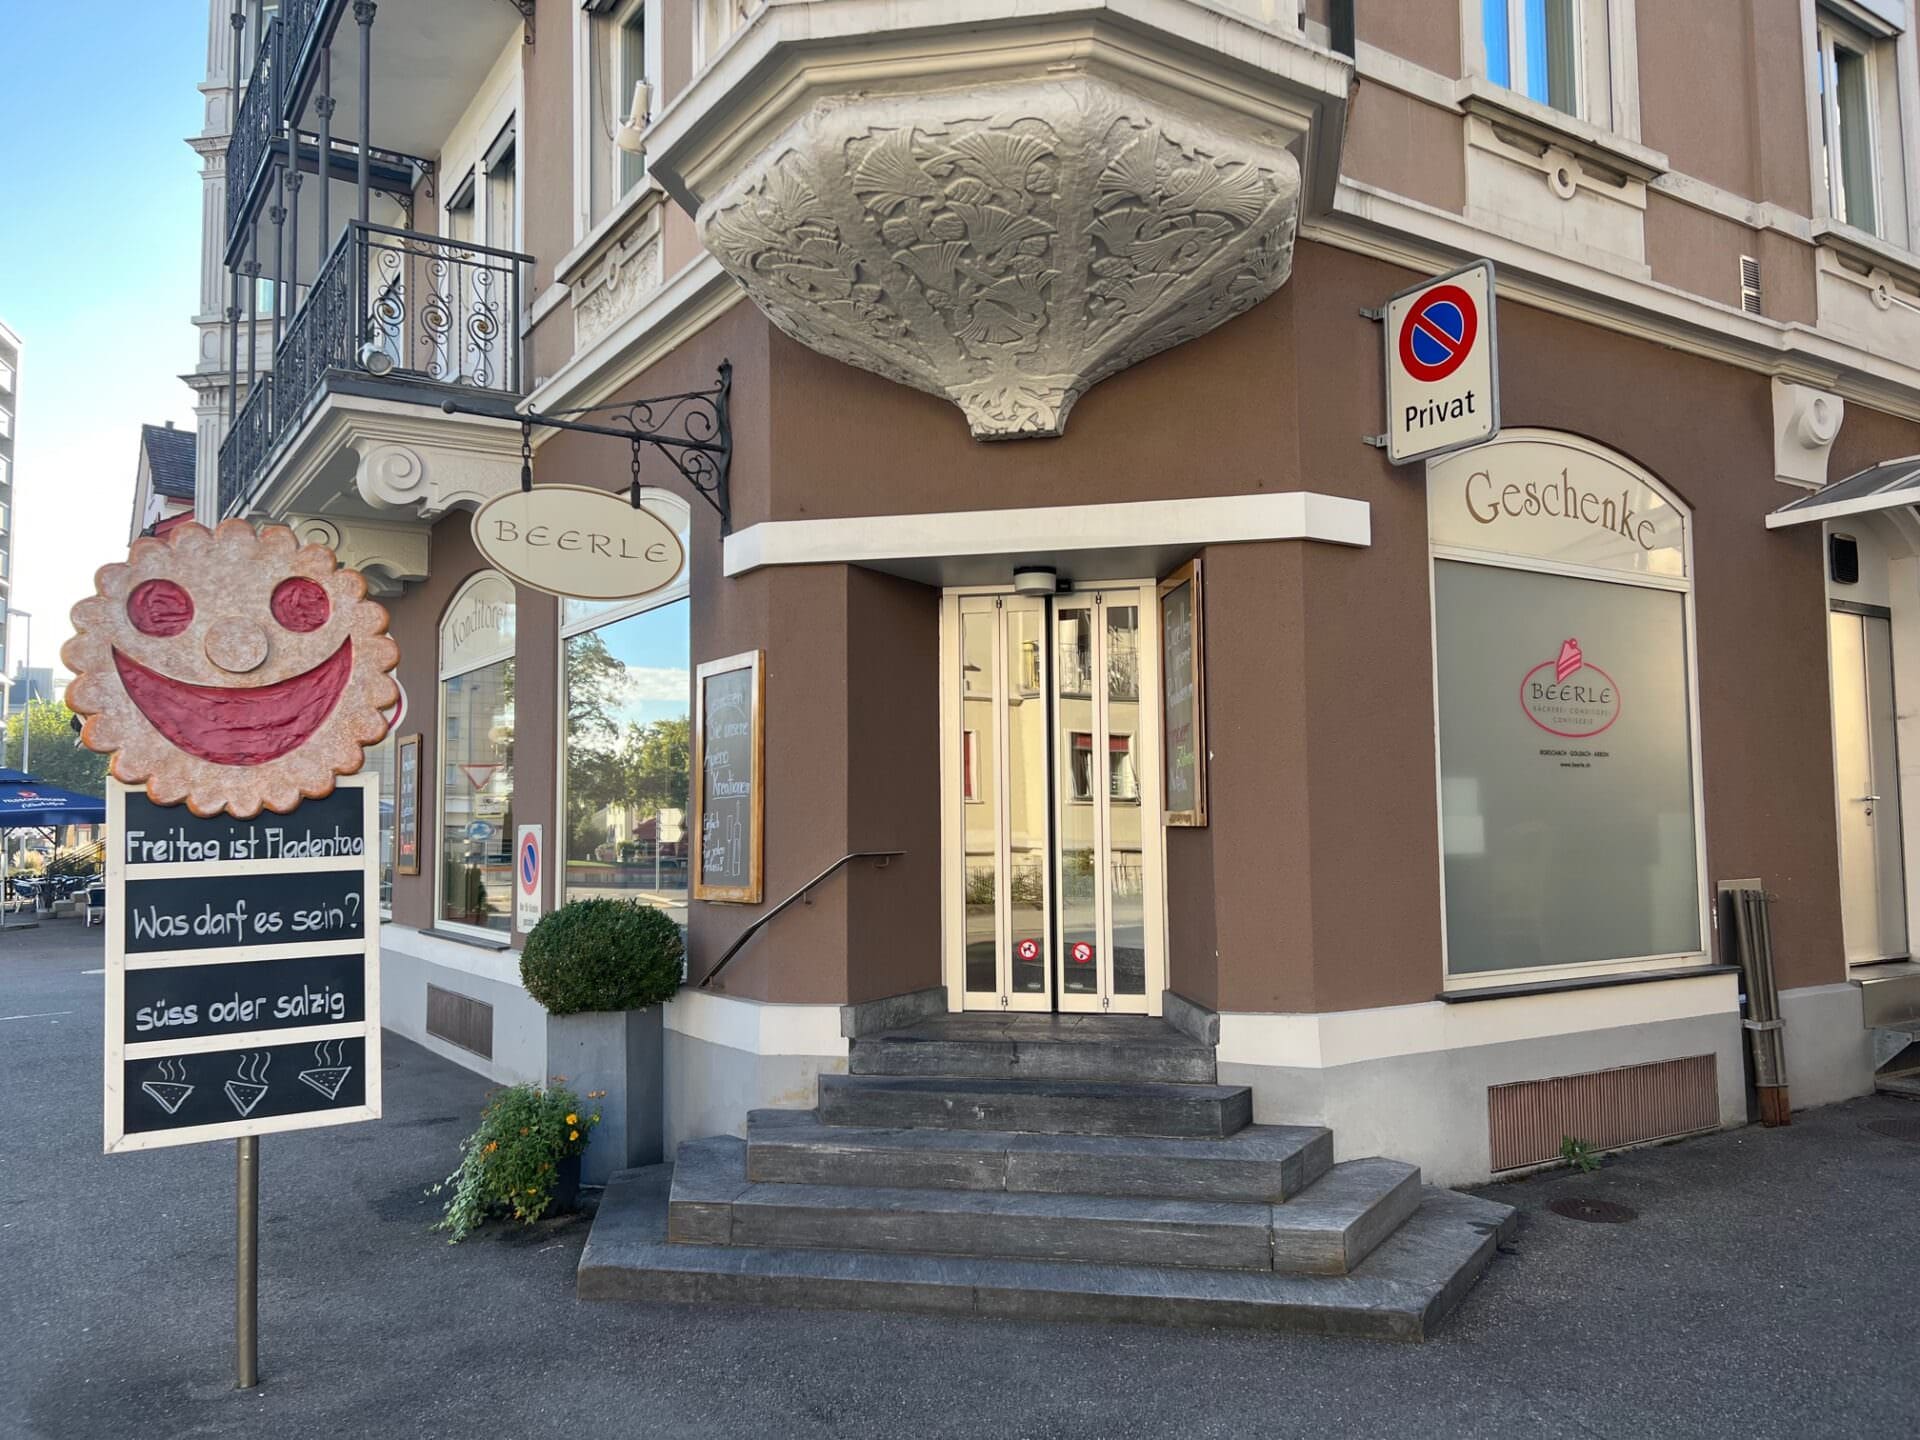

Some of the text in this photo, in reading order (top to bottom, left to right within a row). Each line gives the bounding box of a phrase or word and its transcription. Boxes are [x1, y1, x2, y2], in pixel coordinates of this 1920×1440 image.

[1406, 390, 1475, 432] Privat
[1465, 467, 1656, 550] Geschenke
[494, 520, 669, 562] BEERLE
[1531, 682, 1611, 704] BEERLE
[127, 825, 364, 863] Freitag ist Fladentag
[133, 892, 361, 942] Was darf es sein?
[136, 984, 345, 1031] süss oder salzig
